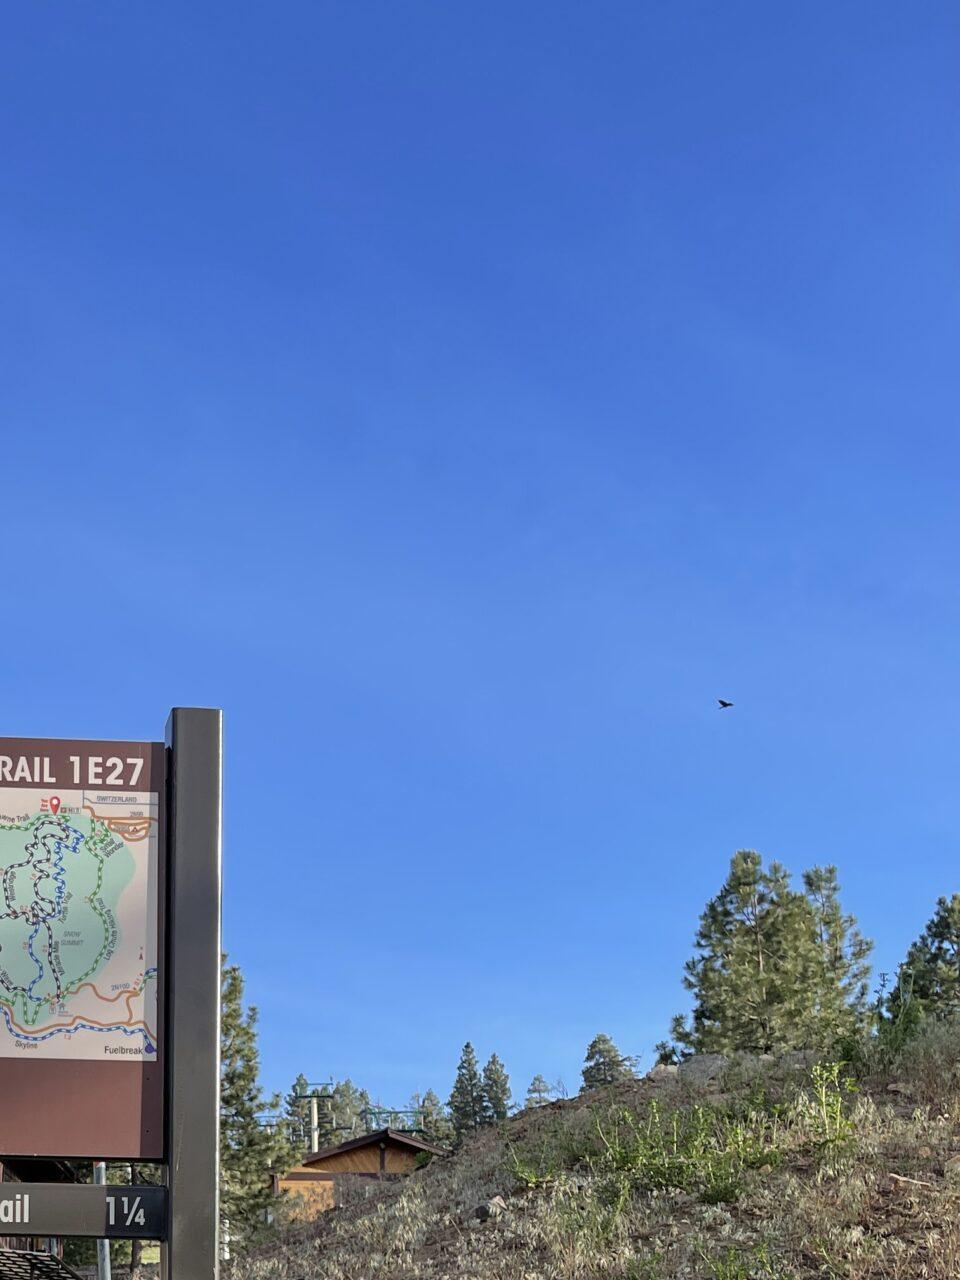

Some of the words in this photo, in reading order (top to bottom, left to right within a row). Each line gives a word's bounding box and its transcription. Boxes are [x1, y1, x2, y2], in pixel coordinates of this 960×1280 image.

[69, 756, 144, 786] 1E27
[16, 813, 30, 821] Trail
[104, 950, 114, 961] Log
[15, 1040, 38, 1049] Skyline
[104, 1046, 143, 1055] Fuelbreak
